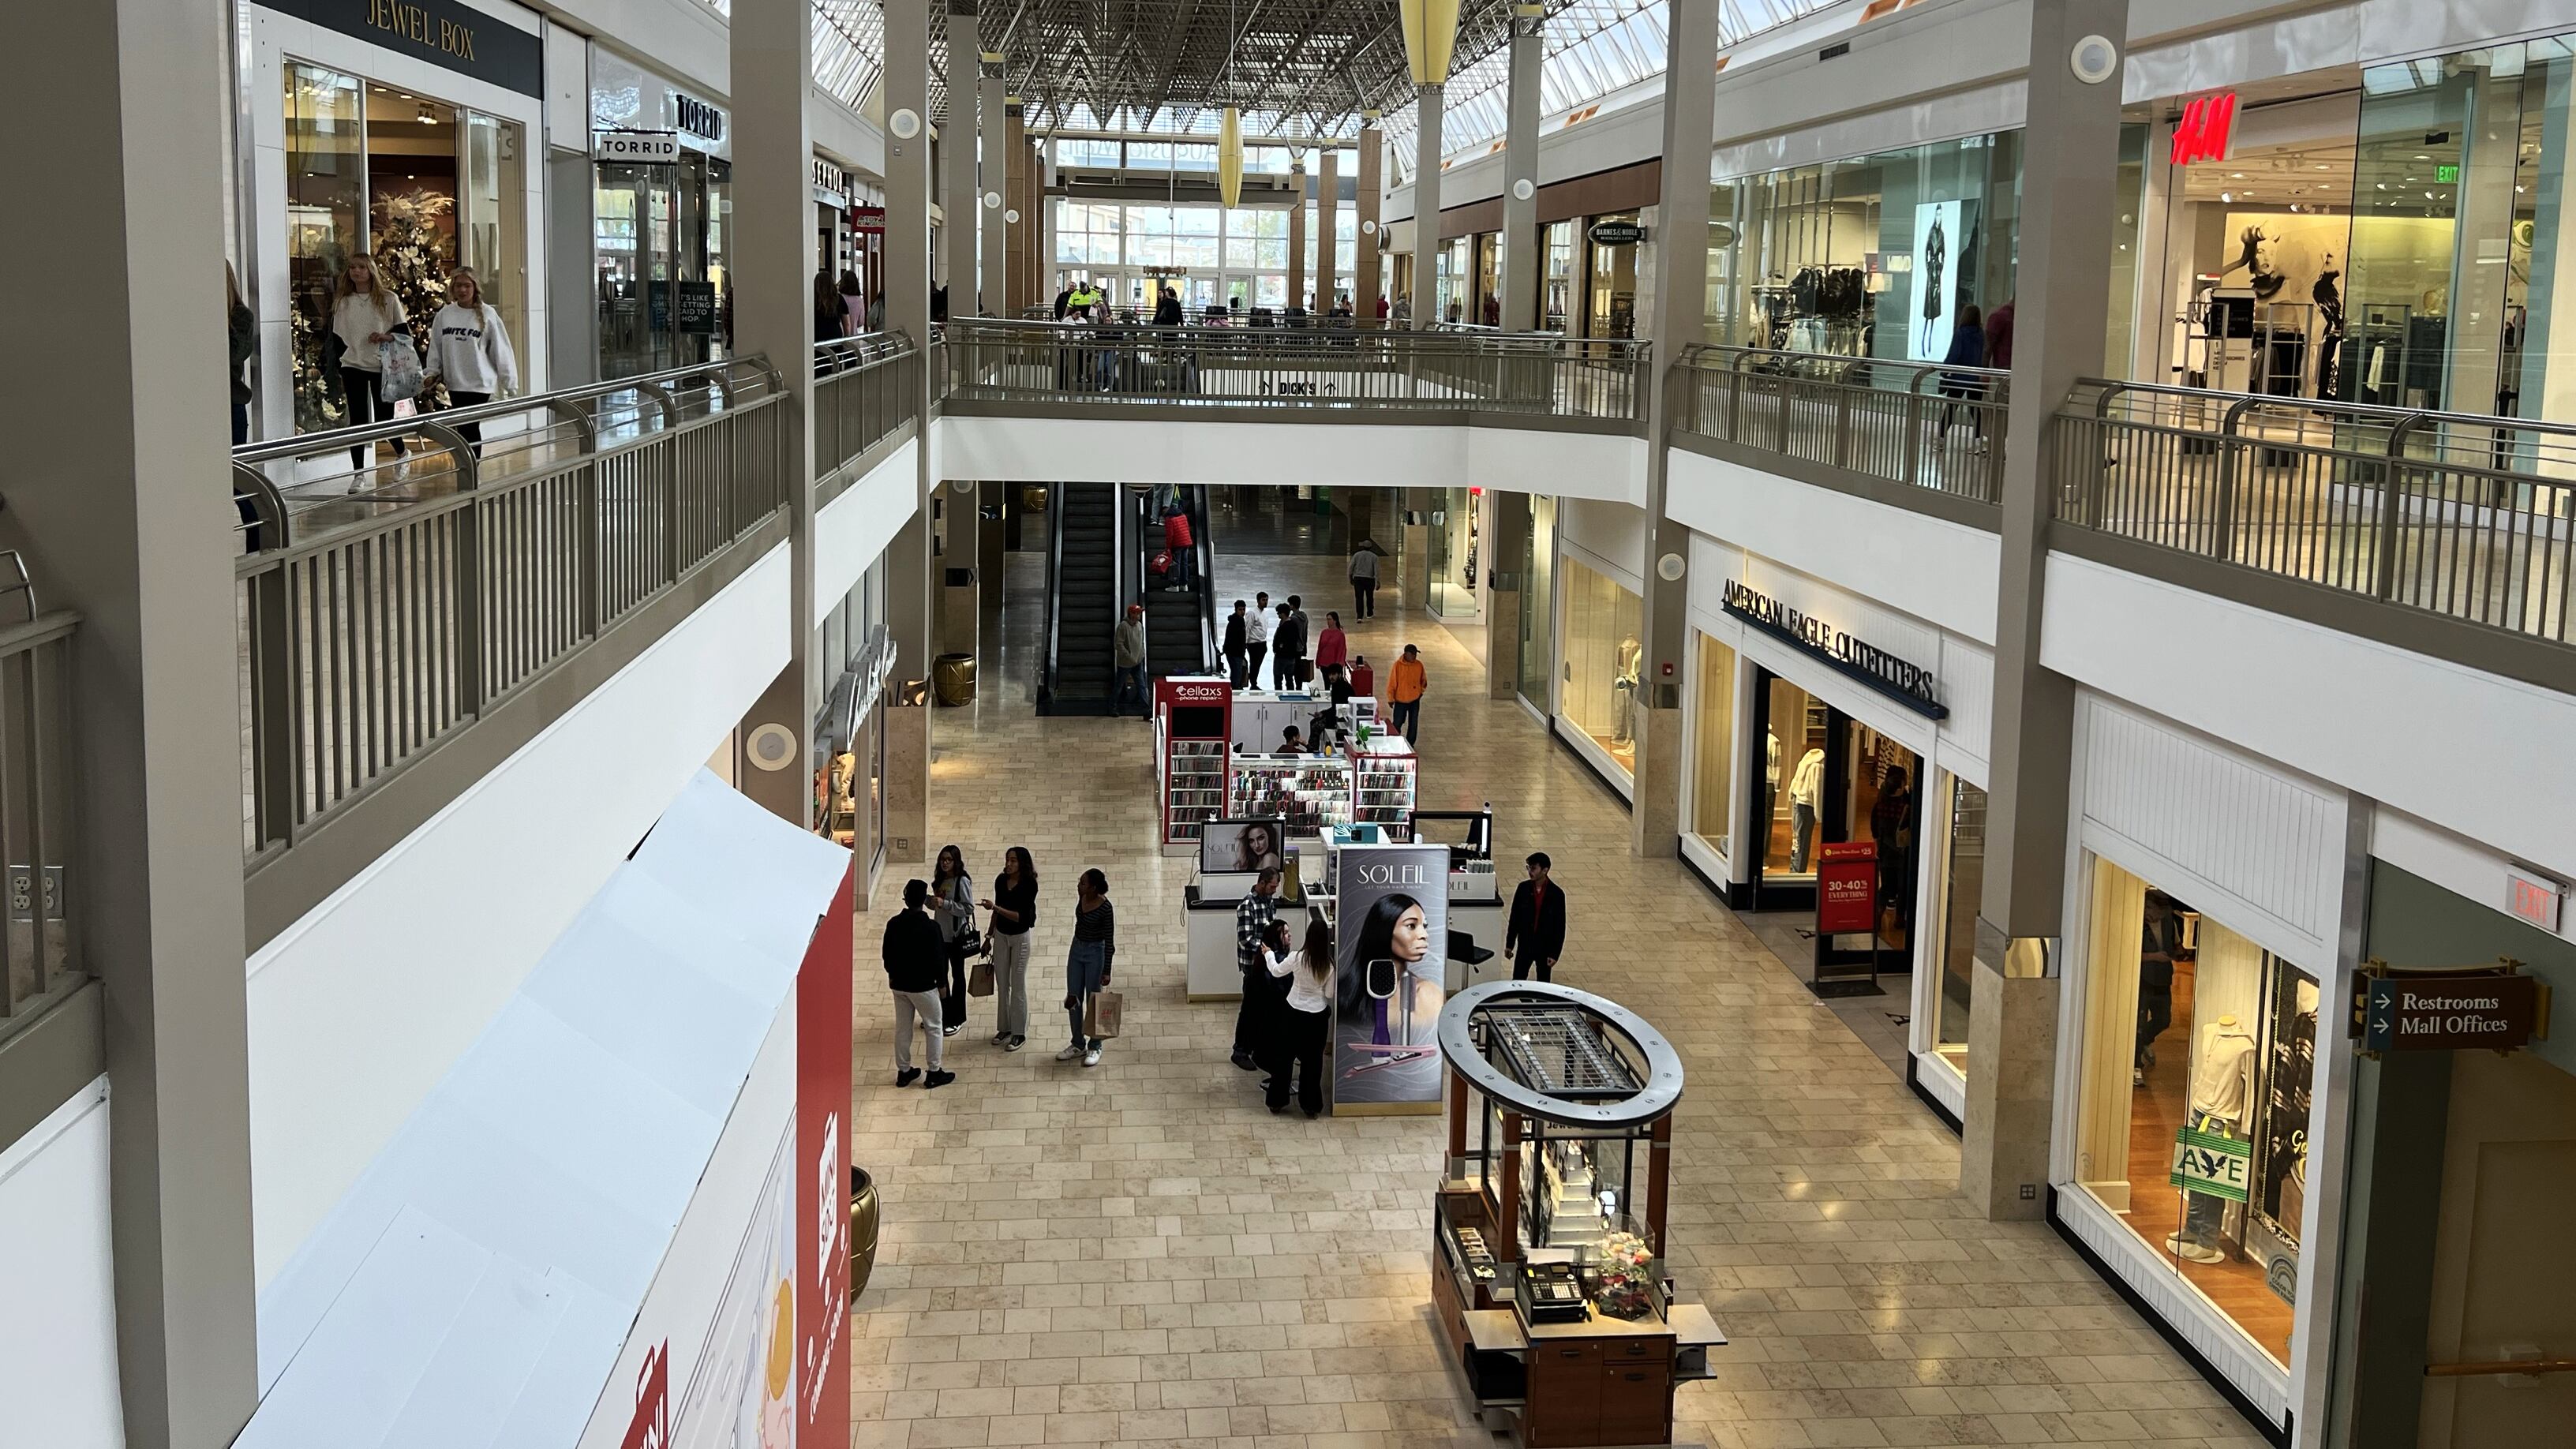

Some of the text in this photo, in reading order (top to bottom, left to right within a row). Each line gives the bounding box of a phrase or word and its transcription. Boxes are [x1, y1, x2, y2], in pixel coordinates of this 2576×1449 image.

[367, 0, 475, 62] JEWEL BOX
[676, 95, 722, 140] TORRID
[2171, 92, 2235, 166] H&M
[604, 140, 673, 154] TORRID
[2439, 166, 2458, 182] EXIT
[1280, 382, 1316, 395] DICK'S
[1723, 578, 1933, 702] AMERICAN EAGLE OUTFITTERS
[1357, 864, 1431, 884] SOLEIL
[1829, 880, 1861, 890] 30-40
[2515, 879, 2550, 923] EXIT
[2402, 993, 2499, 1010] Restrooms
[2400, 1015, 2508, 1035] Mall Offices
[811, 1287, 844, 1425] COMING SOON
